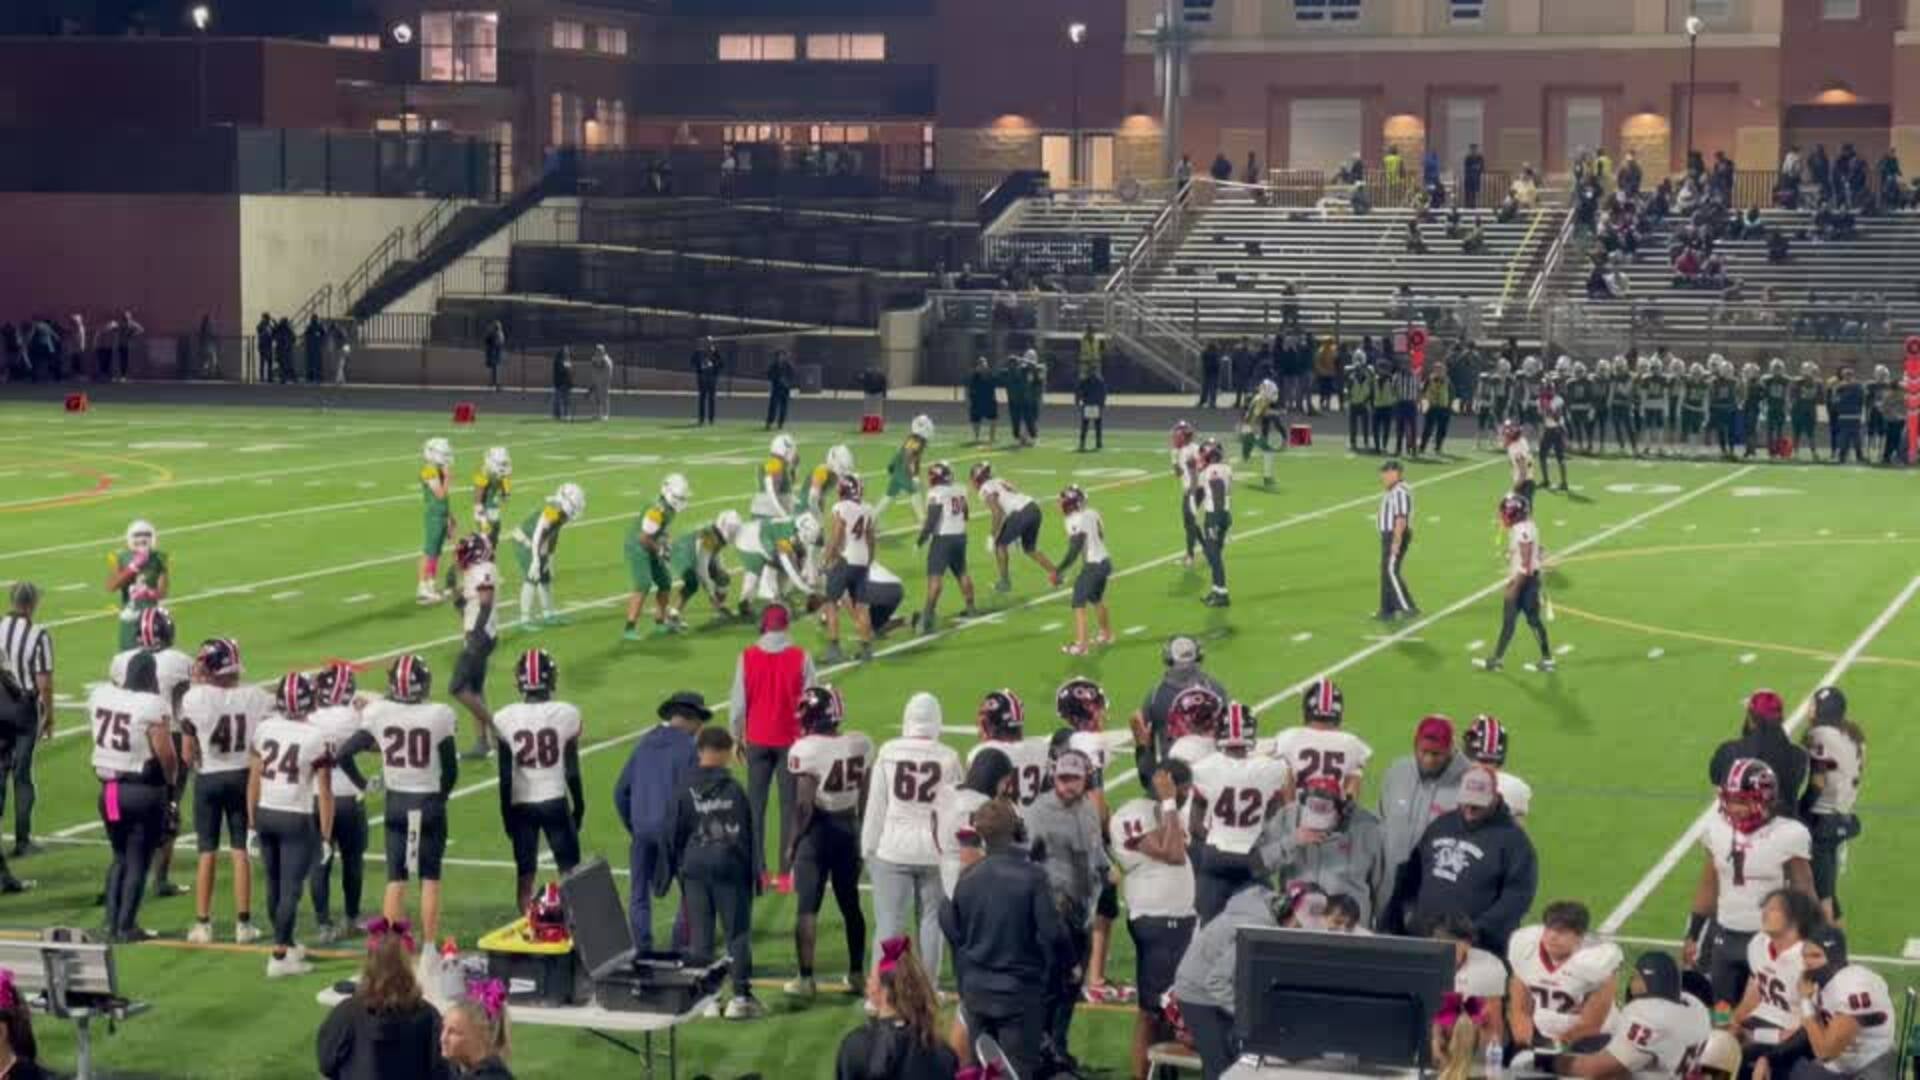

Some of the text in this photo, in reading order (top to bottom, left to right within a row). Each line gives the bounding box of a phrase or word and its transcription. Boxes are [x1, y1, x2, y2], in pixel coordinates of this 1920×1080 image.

[93, 707, 132, 751] 75
[211, 714, 246, 751] 41
[384, 726, 431, 768] 20
[513, 728, 560, 768] 28
[260, 740, 301, 782] 24
[823, 755, 866, 793] 45
[892, 761, 942, 802] 62
[1298, 748, 1344, 783] 25
[1213, 787, 1261, 829] 42
